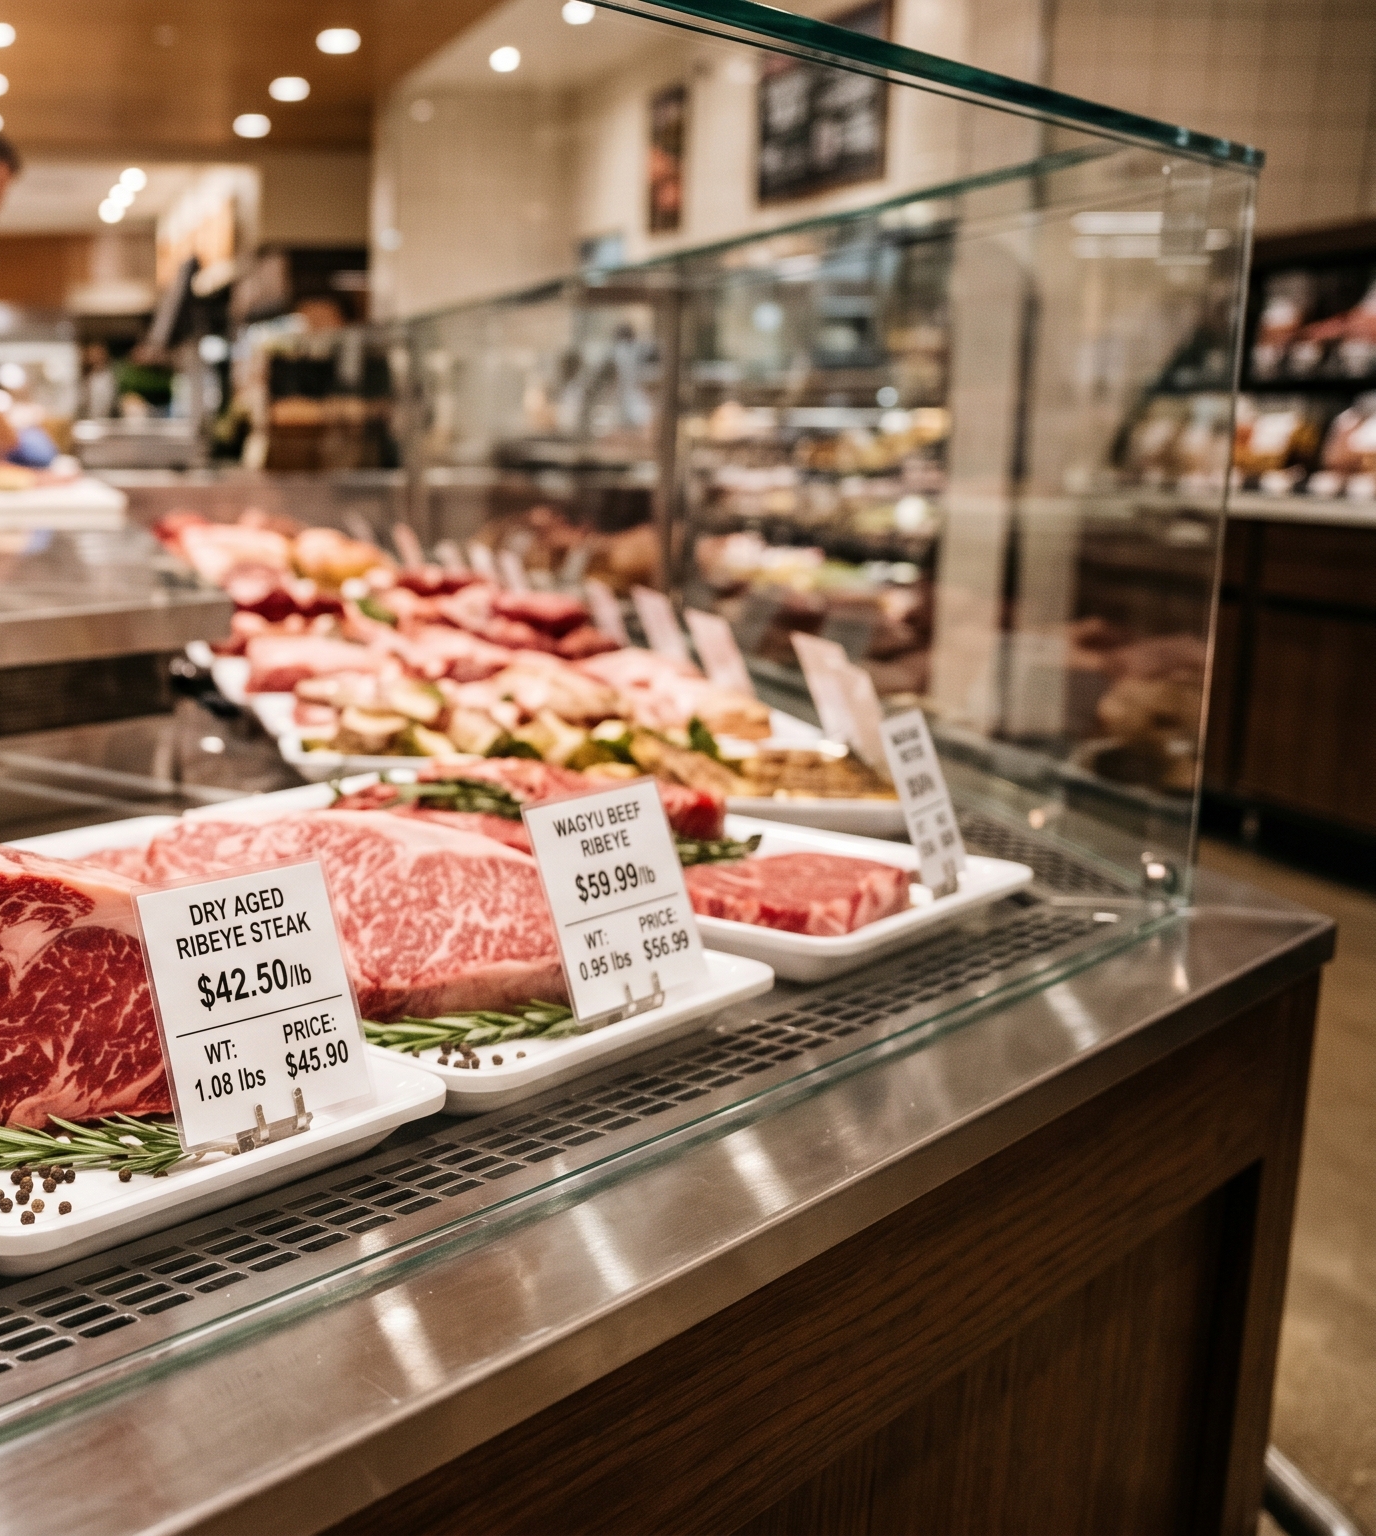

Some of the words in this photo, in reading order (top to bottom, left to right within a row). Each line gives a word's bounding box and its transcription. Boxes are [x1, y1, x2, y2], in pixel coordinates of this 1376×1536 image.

[552, 810, 605, 838] WAGYU
[607, 801, 641, 824] BEEF
[580, 829, 631, 857] RIBEYE
[575, 862, 656, 903] $59.99/lb
[189, 898, 227, 926] DRY
[234, 887, 285, 917] AGED
[638, 908, 679, 933] PRICE:
[176, 926, 246, 959] RIBEYE
[250, 911, 311, 943] STEAK
[584, 929, 610, 950] WT:
[643, 930, 689, 961] $56.99
[579, 956, 608, 981] 0.95
[611, 951, 632, 971] lbs
[197, 958, 312, 1012] $42.50/lb
[282, 1013, 337, 1044] PRICE:
[204, 1039, 238, 1065] WT:
[285, 1039, 349, 1081] $45.90
[194, 1072, 234, 1102] 1.08
[238, 1067, 266, 1091] lbs
